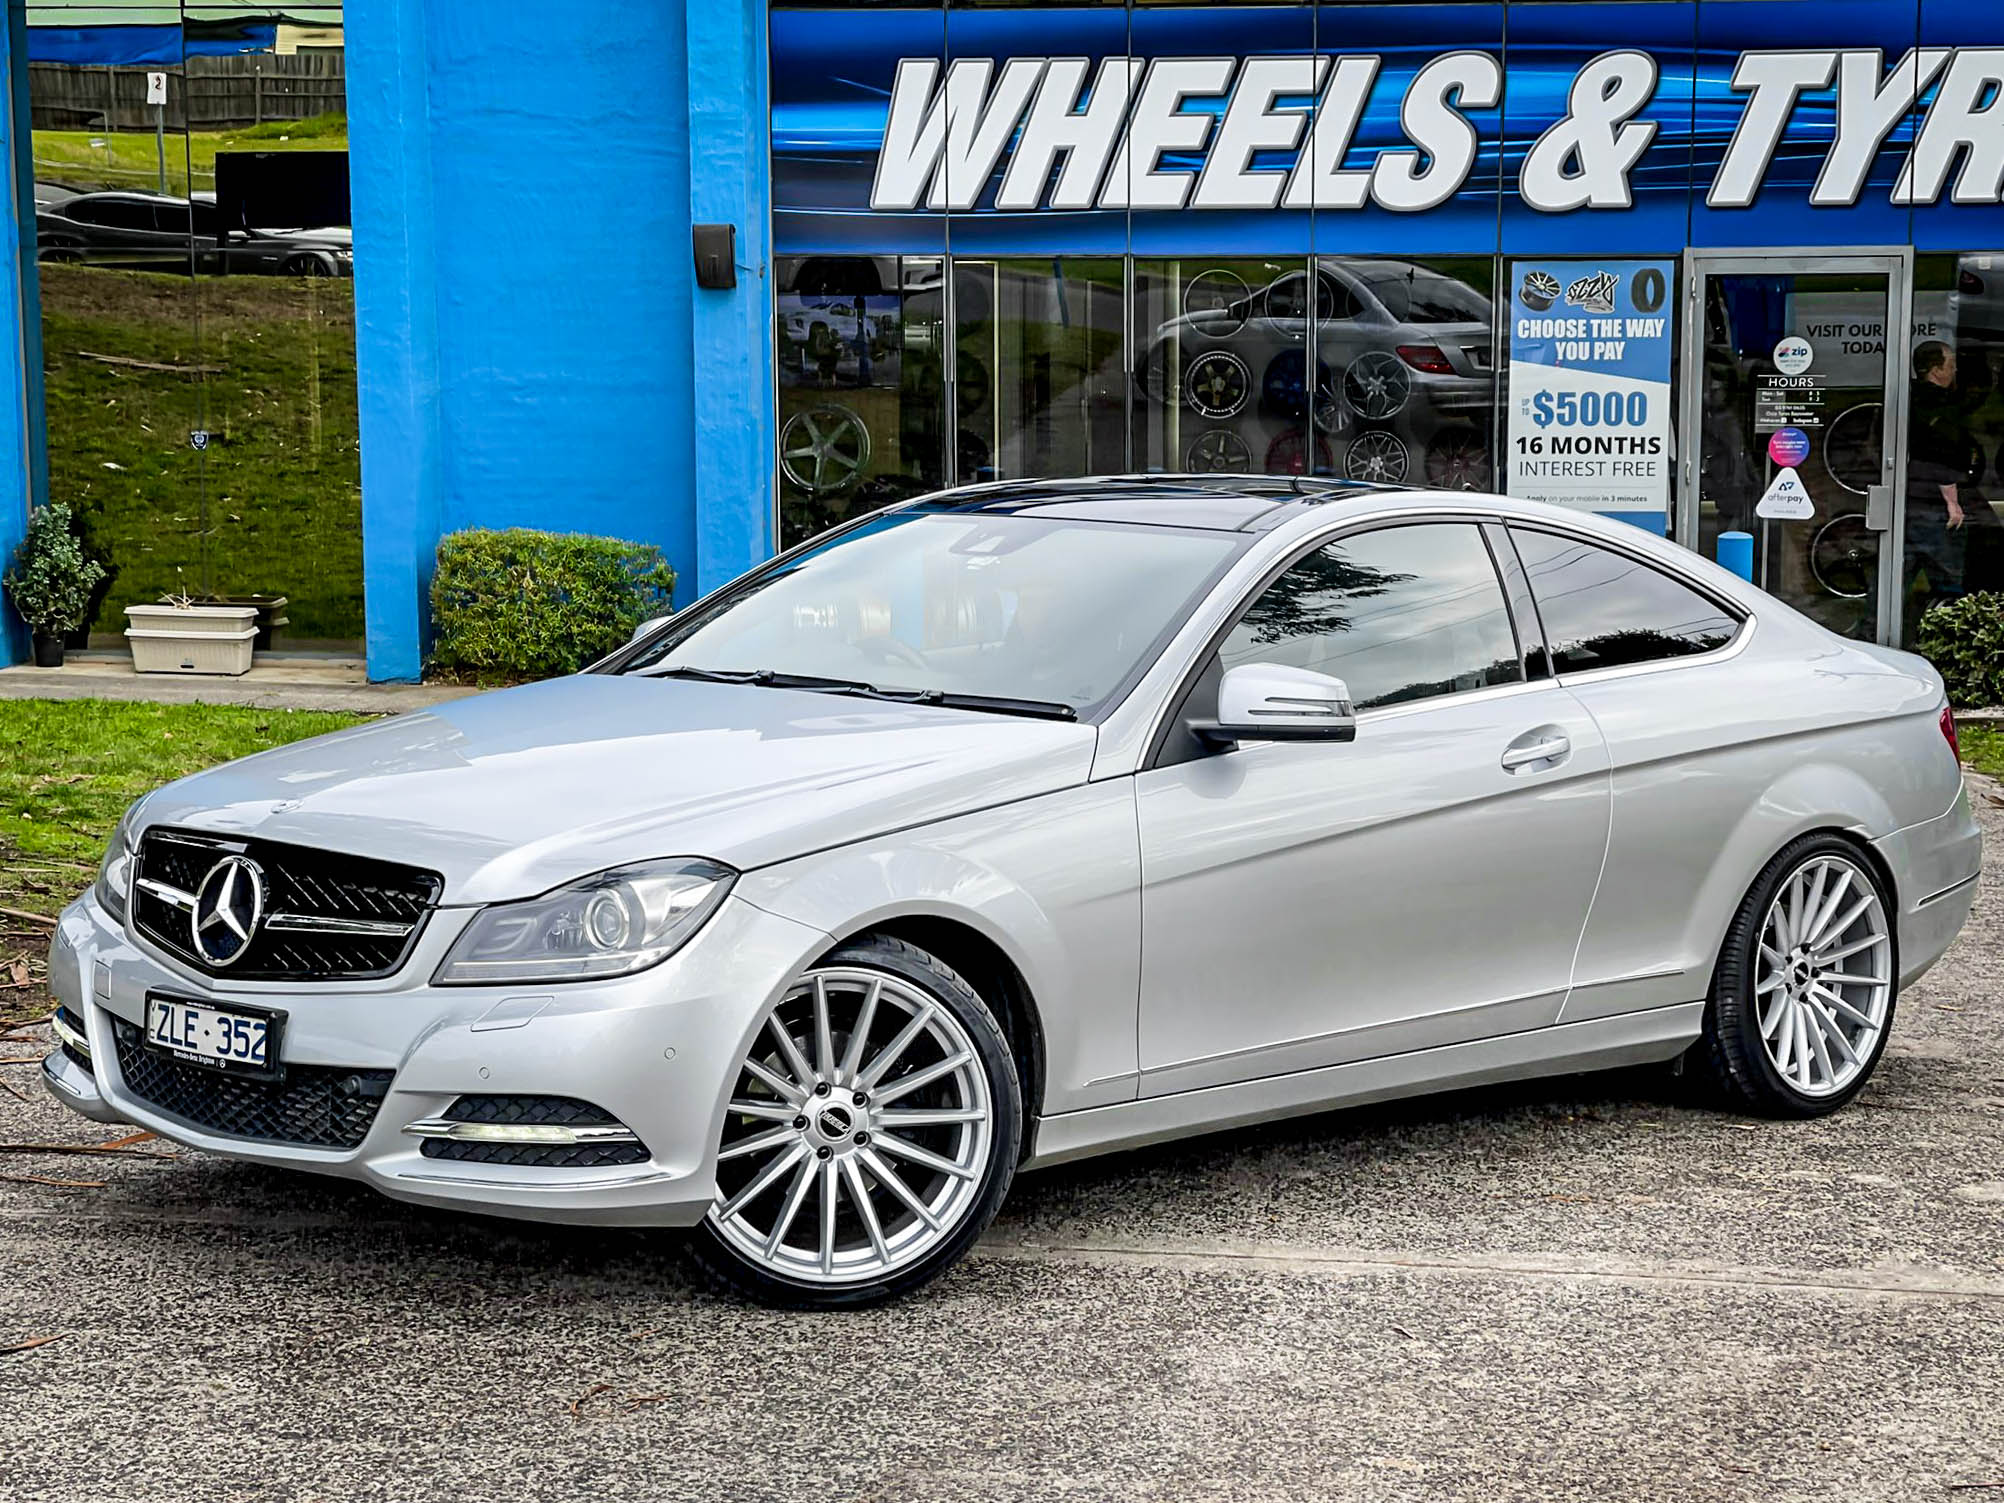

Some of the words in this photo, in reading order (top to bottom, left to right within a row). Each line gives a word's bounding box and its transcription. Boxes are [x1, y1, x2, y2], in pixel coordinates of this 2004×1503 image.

[870, 50, 1502, 212] WHEELS
[1519, 49, 1658, 212] &
[1706, 47, 2004, 205] TYR
[1517, 319, 1587, 338] CHOOSE
[1590, 319, 1622, 338] THE
[1626, 318, 1666, 338] WAY
[1806, 324, 1845, 338] VISIT
[1848, 324, 1883, 337] OUR
[1555, 341, 1591, 360] YOU
[1593, 341, 1626, 360] PAY
[1791, 346, 1808, 357] zip
[1841, 341, 1886, 354] TODA
[1768, 377, 1815, 387] HOURS
[1532, 389, 1648, 429] $5000
[1516, 436, 1543, 455] 16
[1551, 436, 1662, 455] MONTHS
[1519, 461, 1607, 477] INTEREST
[1612, 461, 1657, 477] FREE
[1526, 495, 1547, 504] Apply
[1559, 496, 1575, 504] your
[1768, 493, 1804, 504] afterpay
[157, 1003, 200, 1050] ZLE
[215, 1016, 266, 1060] 352
